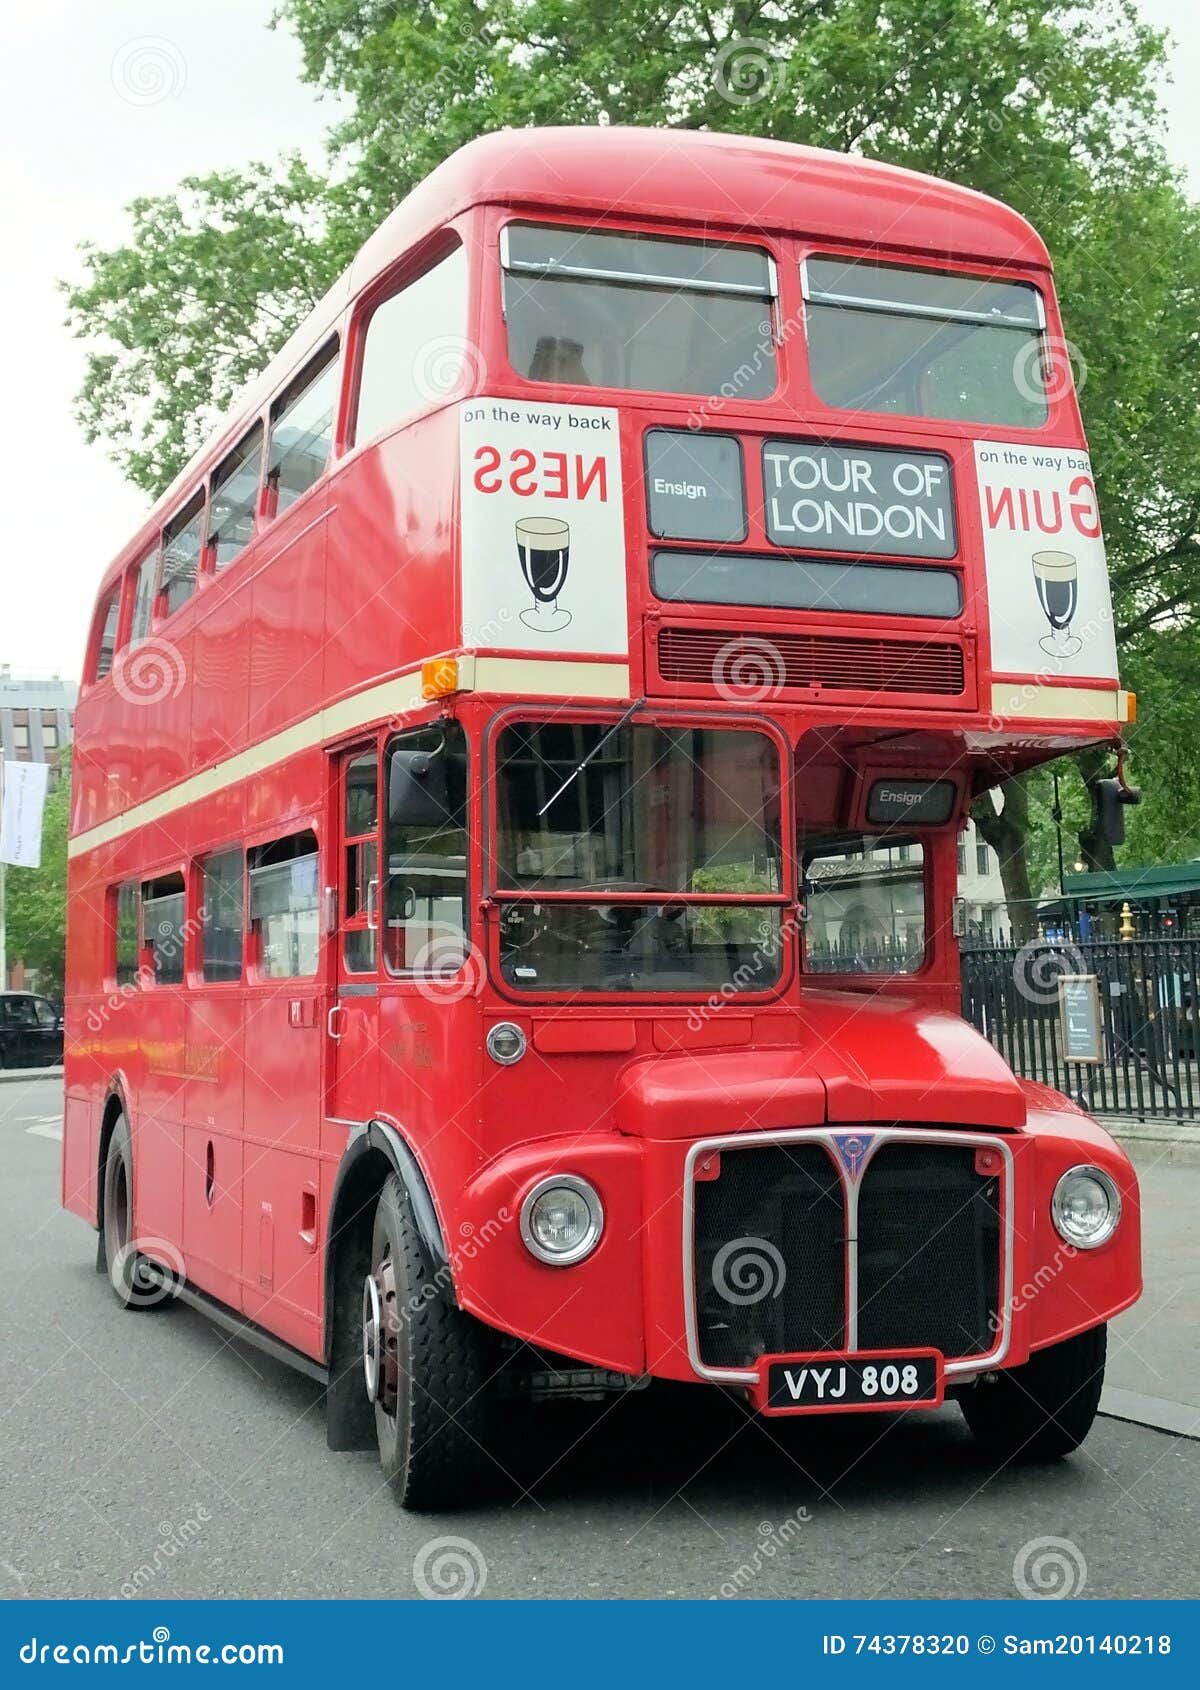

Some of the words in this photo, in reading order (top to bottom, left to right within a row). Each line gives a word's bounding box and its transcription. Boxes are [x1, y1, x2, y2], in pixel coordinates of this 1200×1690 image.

[464, 408, 486, 422] on
[492, 407, 521, 424] the
[527, 413, 562, 430] way
[568, 413, 612, 431] back
[979, 451, 1000, 464] on
[1003, 450, 1028, 466] the
[1032, 456, 1063, 472] way
[765, 453, 877, 494] TOUR
[892, 463, 944, 497] OF
[654, 478, 707, 499] Ensign
[771, 498, 946, 541] LONDON
[879, 789, 922, 806] Ensign
[783, 1367, 846, 1400] VYJ
[861, 1365, 919, 1396] 808
